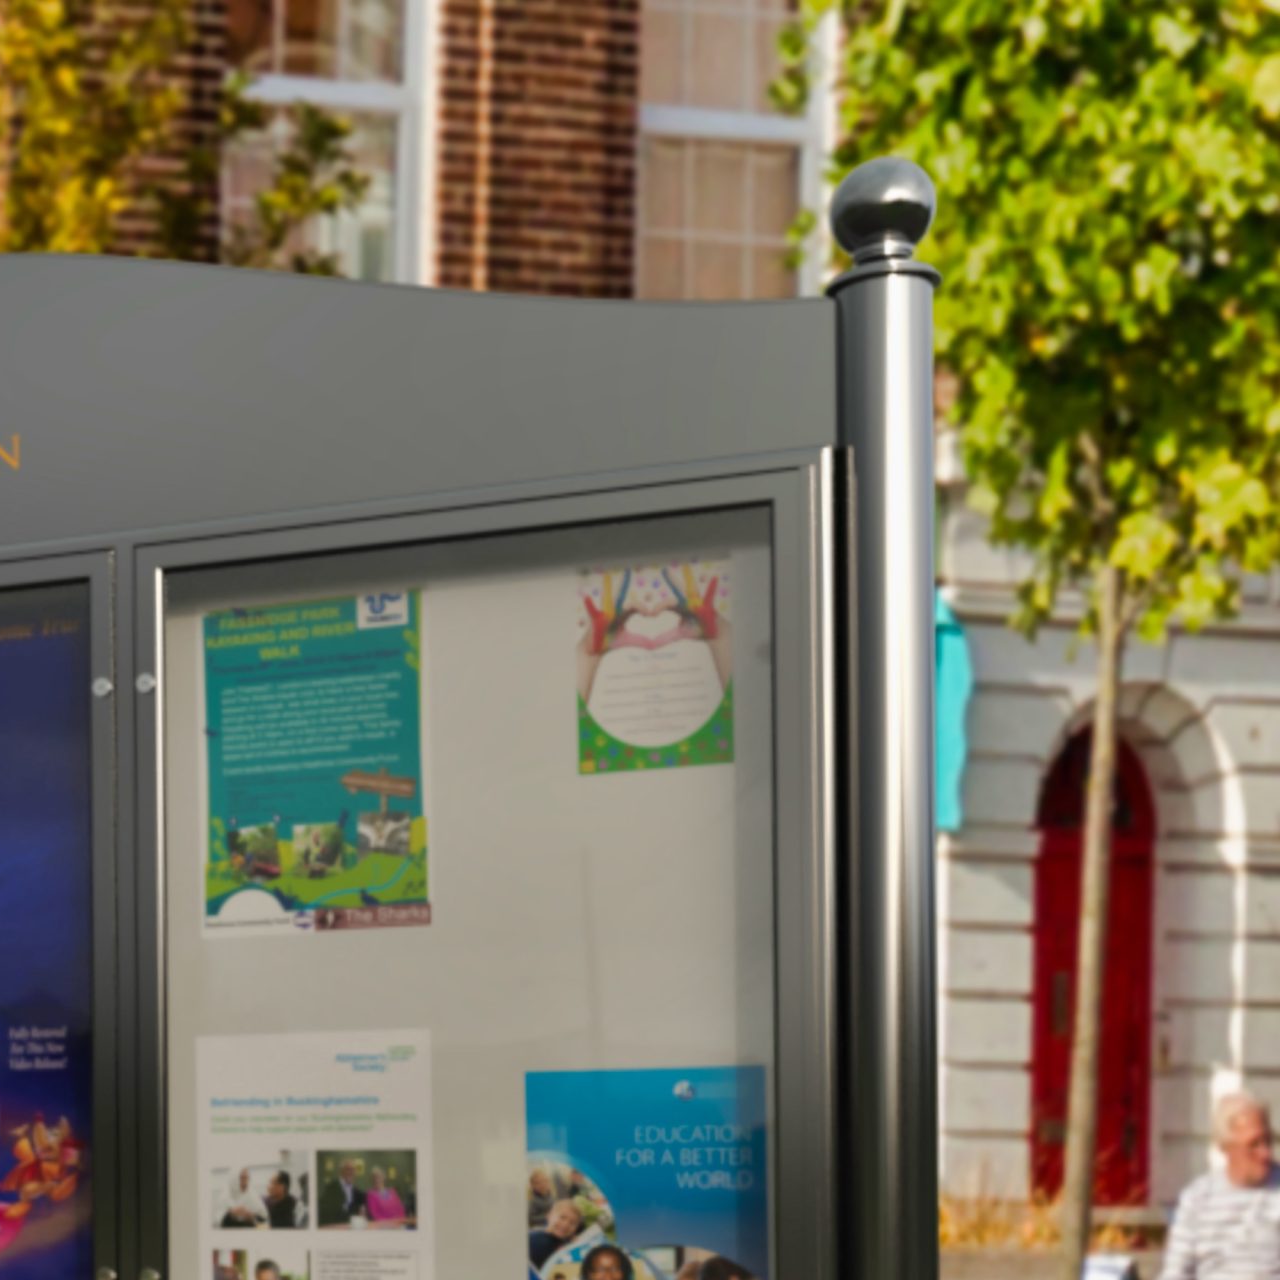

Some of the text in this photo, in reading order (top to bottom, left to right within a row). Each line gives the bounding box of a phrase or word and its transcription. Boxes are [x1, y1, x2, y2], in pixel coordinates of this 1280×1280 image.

[634, 1124, 752, 1144] EDUCATION
[615, 1147, 752, 1167] FOR A BETTER
[676, 1170, 753, 1190] WORLD
